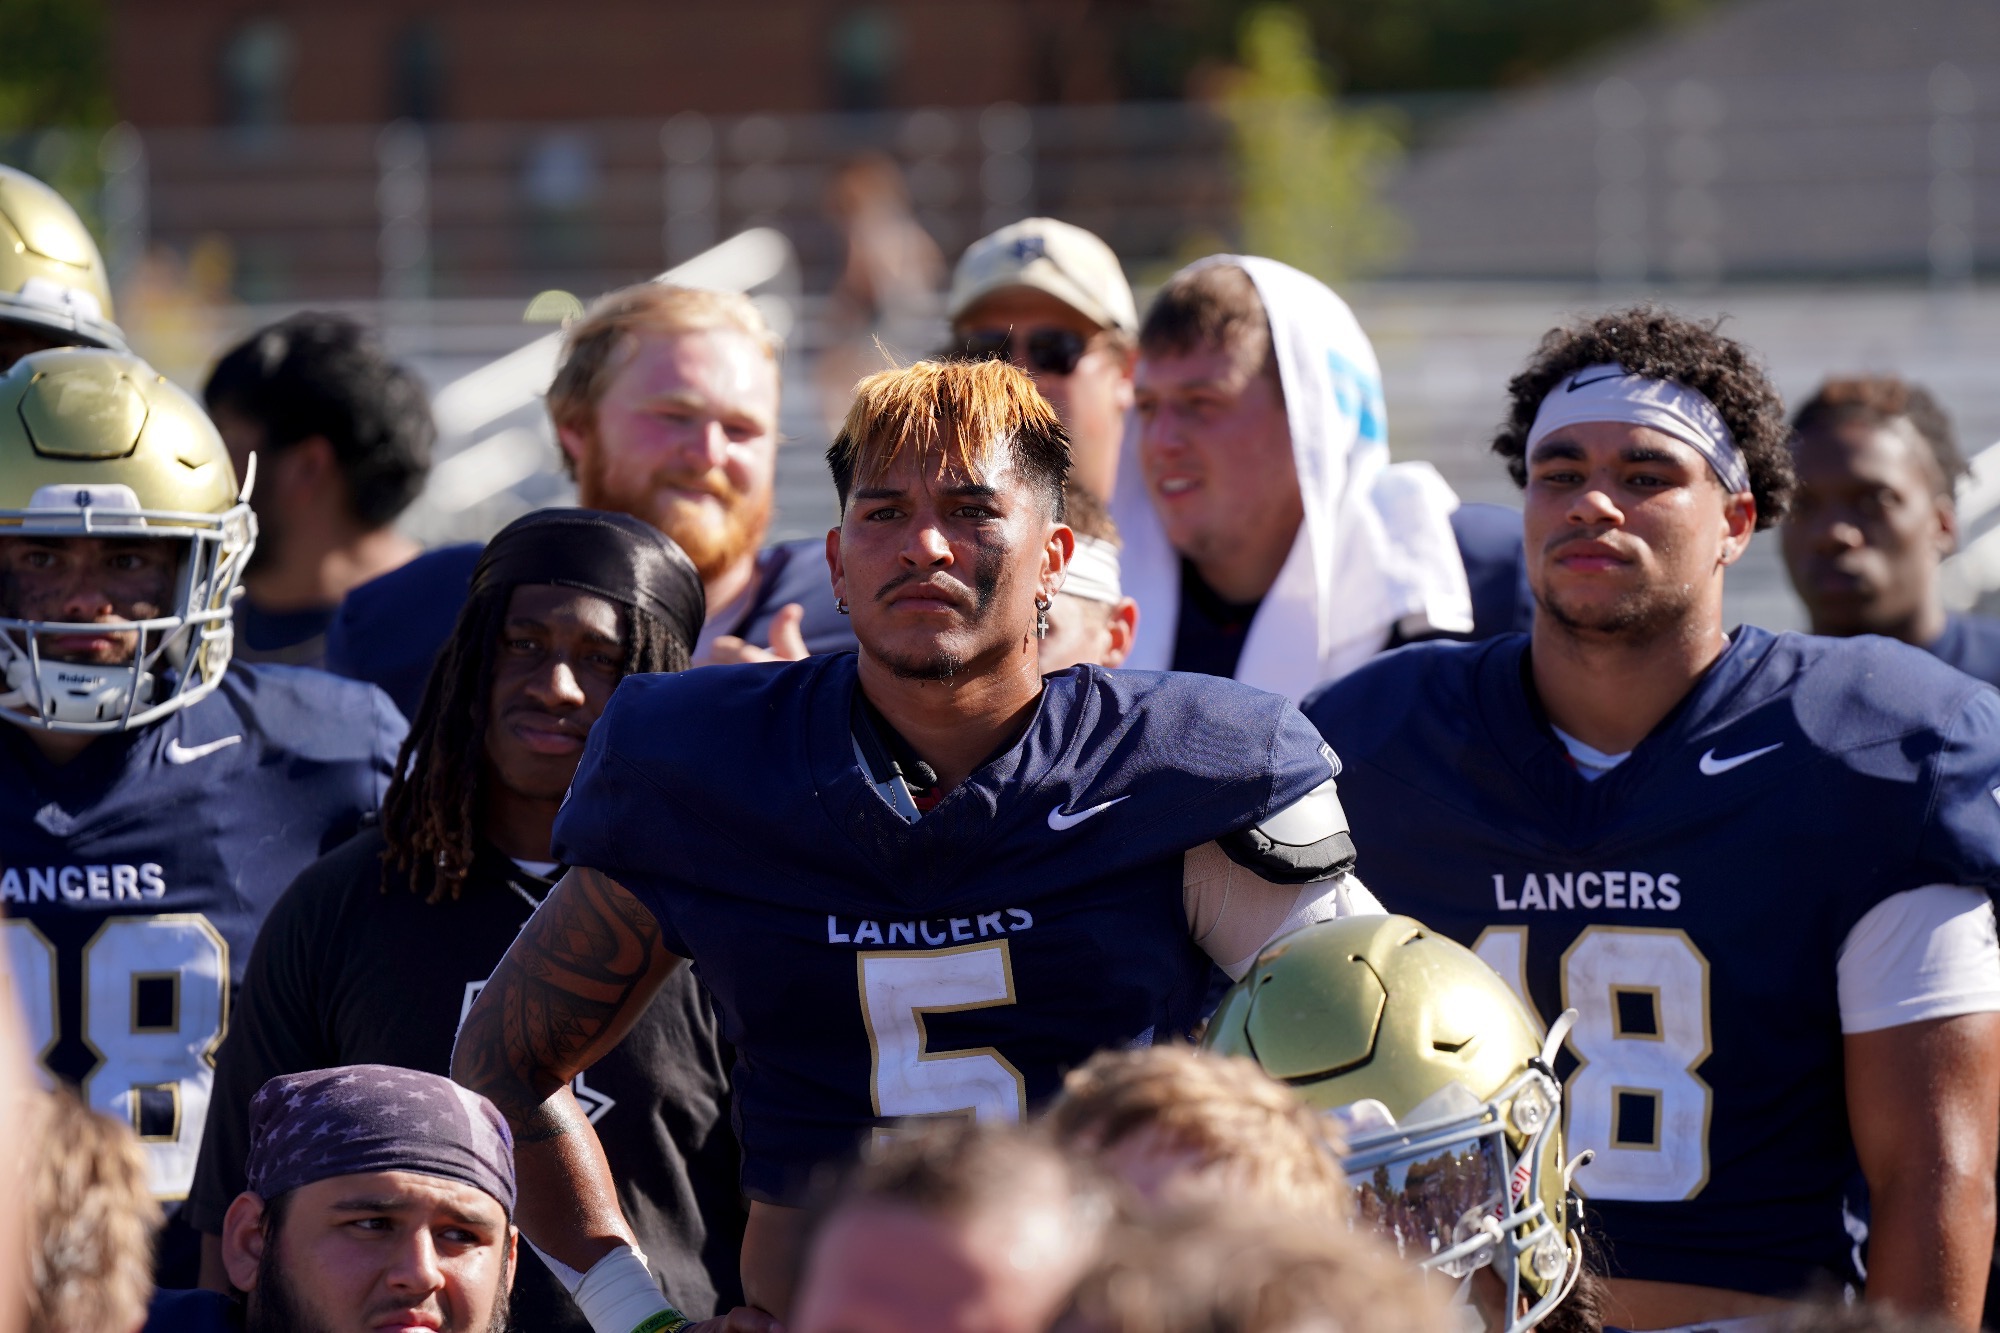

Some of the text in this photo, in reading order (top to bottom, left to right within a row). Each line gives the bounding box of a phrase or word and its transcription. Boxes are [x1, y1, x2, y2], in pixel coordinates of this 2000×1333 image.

[0, 863, 166, 903] ANCERS
[1492, 871, 1681, 911] LANCERS
[828, 908, 1034, 945] LANCERS
[857, 938, 1027, 1145] 5
[1470, 924, 1714, 1202] 8
